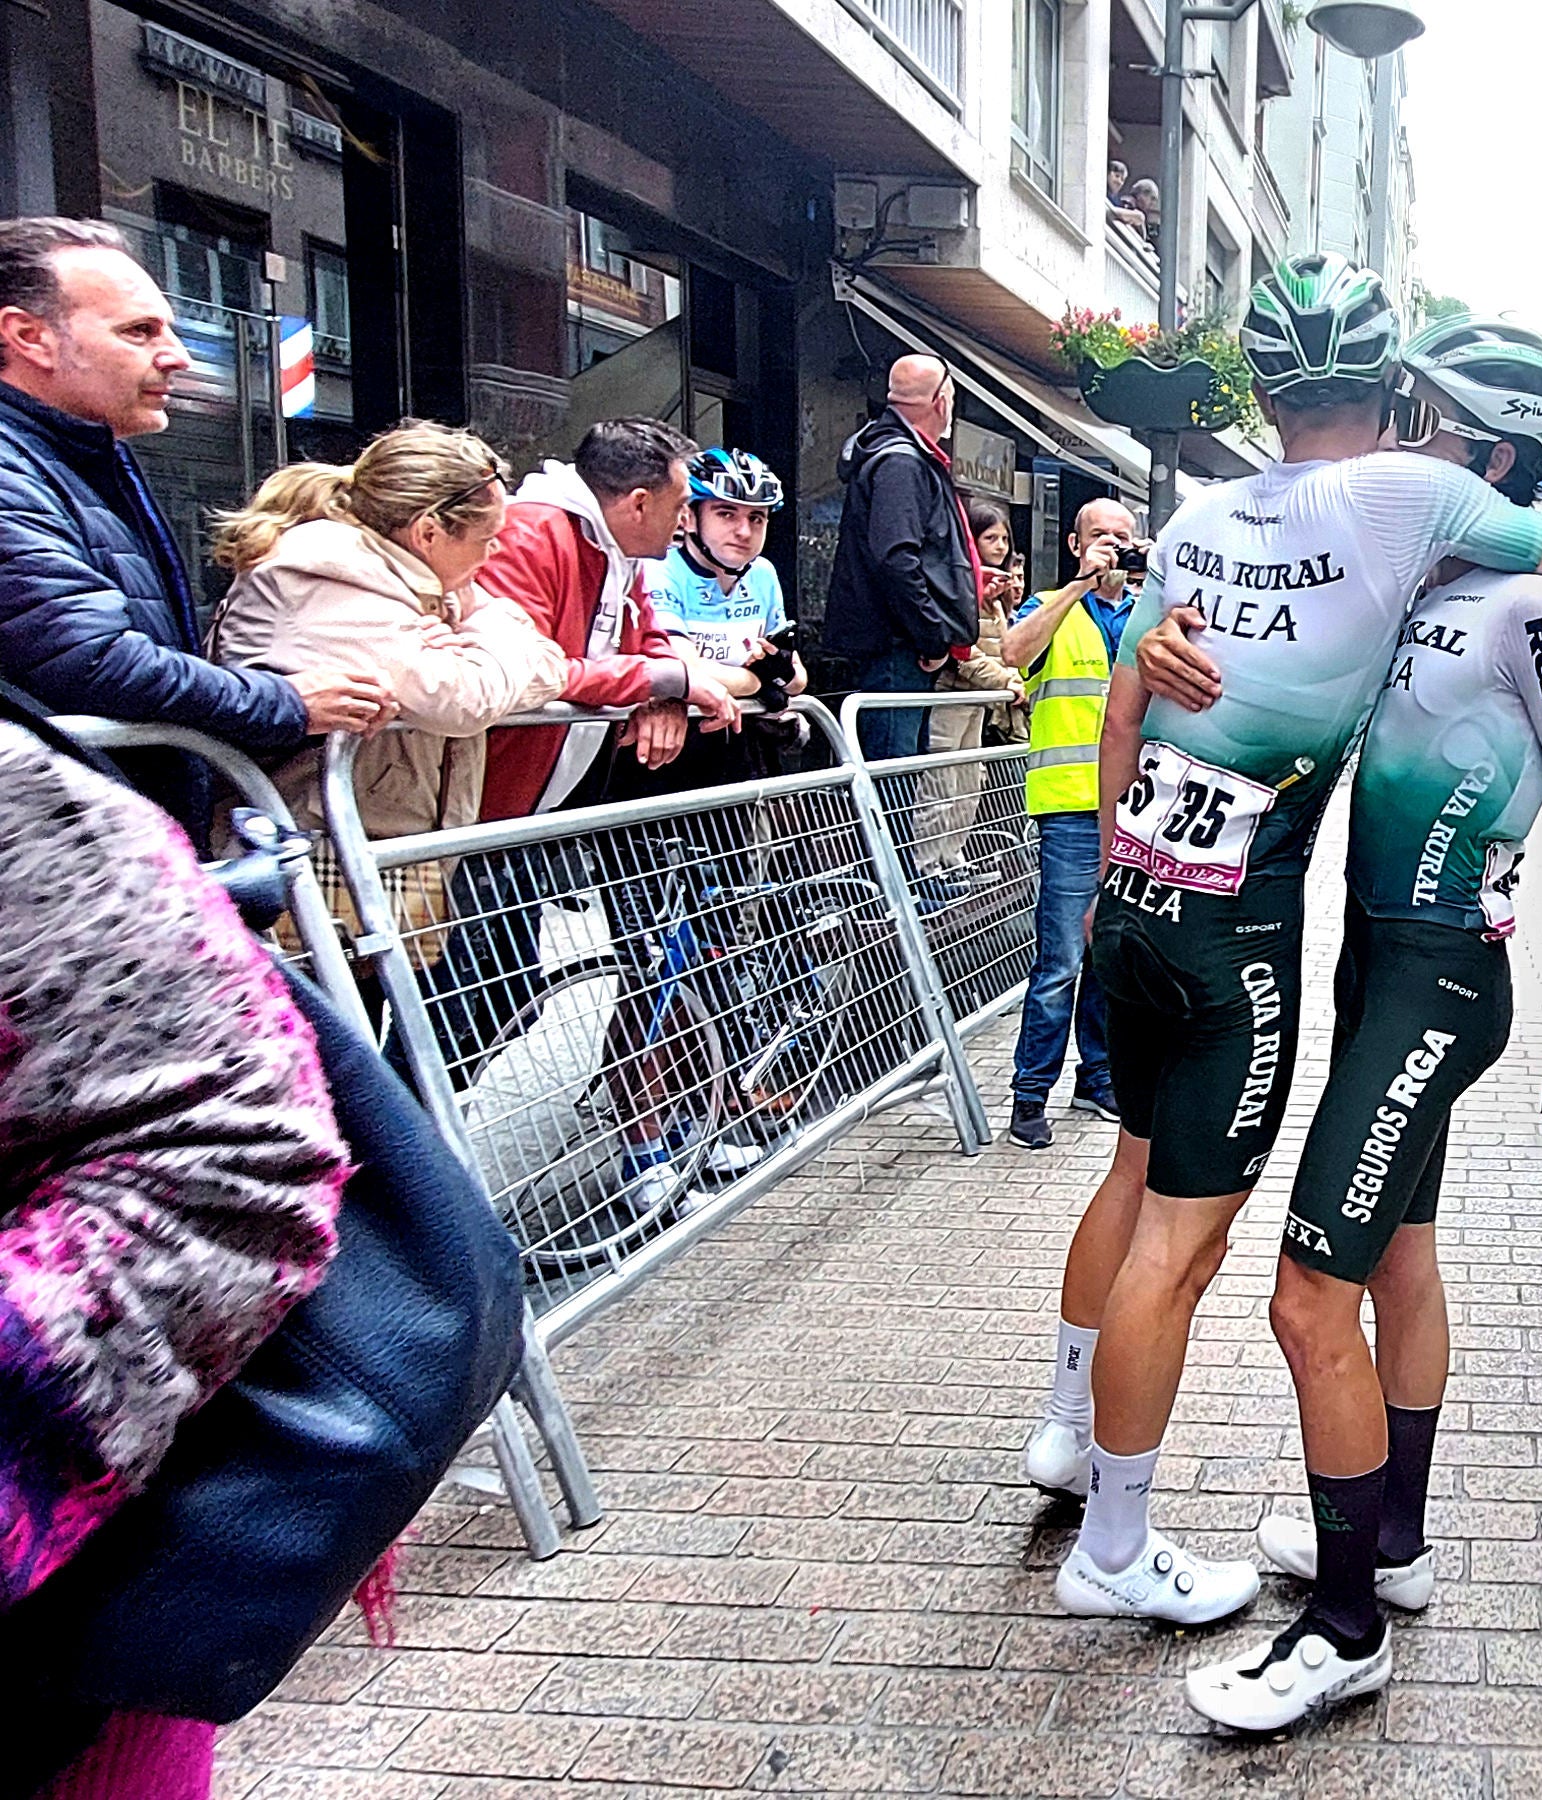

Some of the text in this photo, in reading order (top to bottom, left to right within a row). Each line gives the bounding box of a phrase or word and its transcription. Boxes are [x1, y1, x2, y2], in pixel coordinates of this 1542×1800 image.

[181, 137, 293, 200] BARBERS
[1175, 541, 1345, 591] CAJA RURAL
[1162, 780, 1236, 849] 35
[1411, 760, 1496, 907] CAJA RURAL
[1104, 865, 1183, 923] ALEA
[1235, 921, 1283, 934] GSPORT
[1437, 977, 1479, 1001] GSPORT
[1226, 1031, 1281, 1138] RURAL
[1341, 1028, 1457, 1224] SEGUROS RGA
